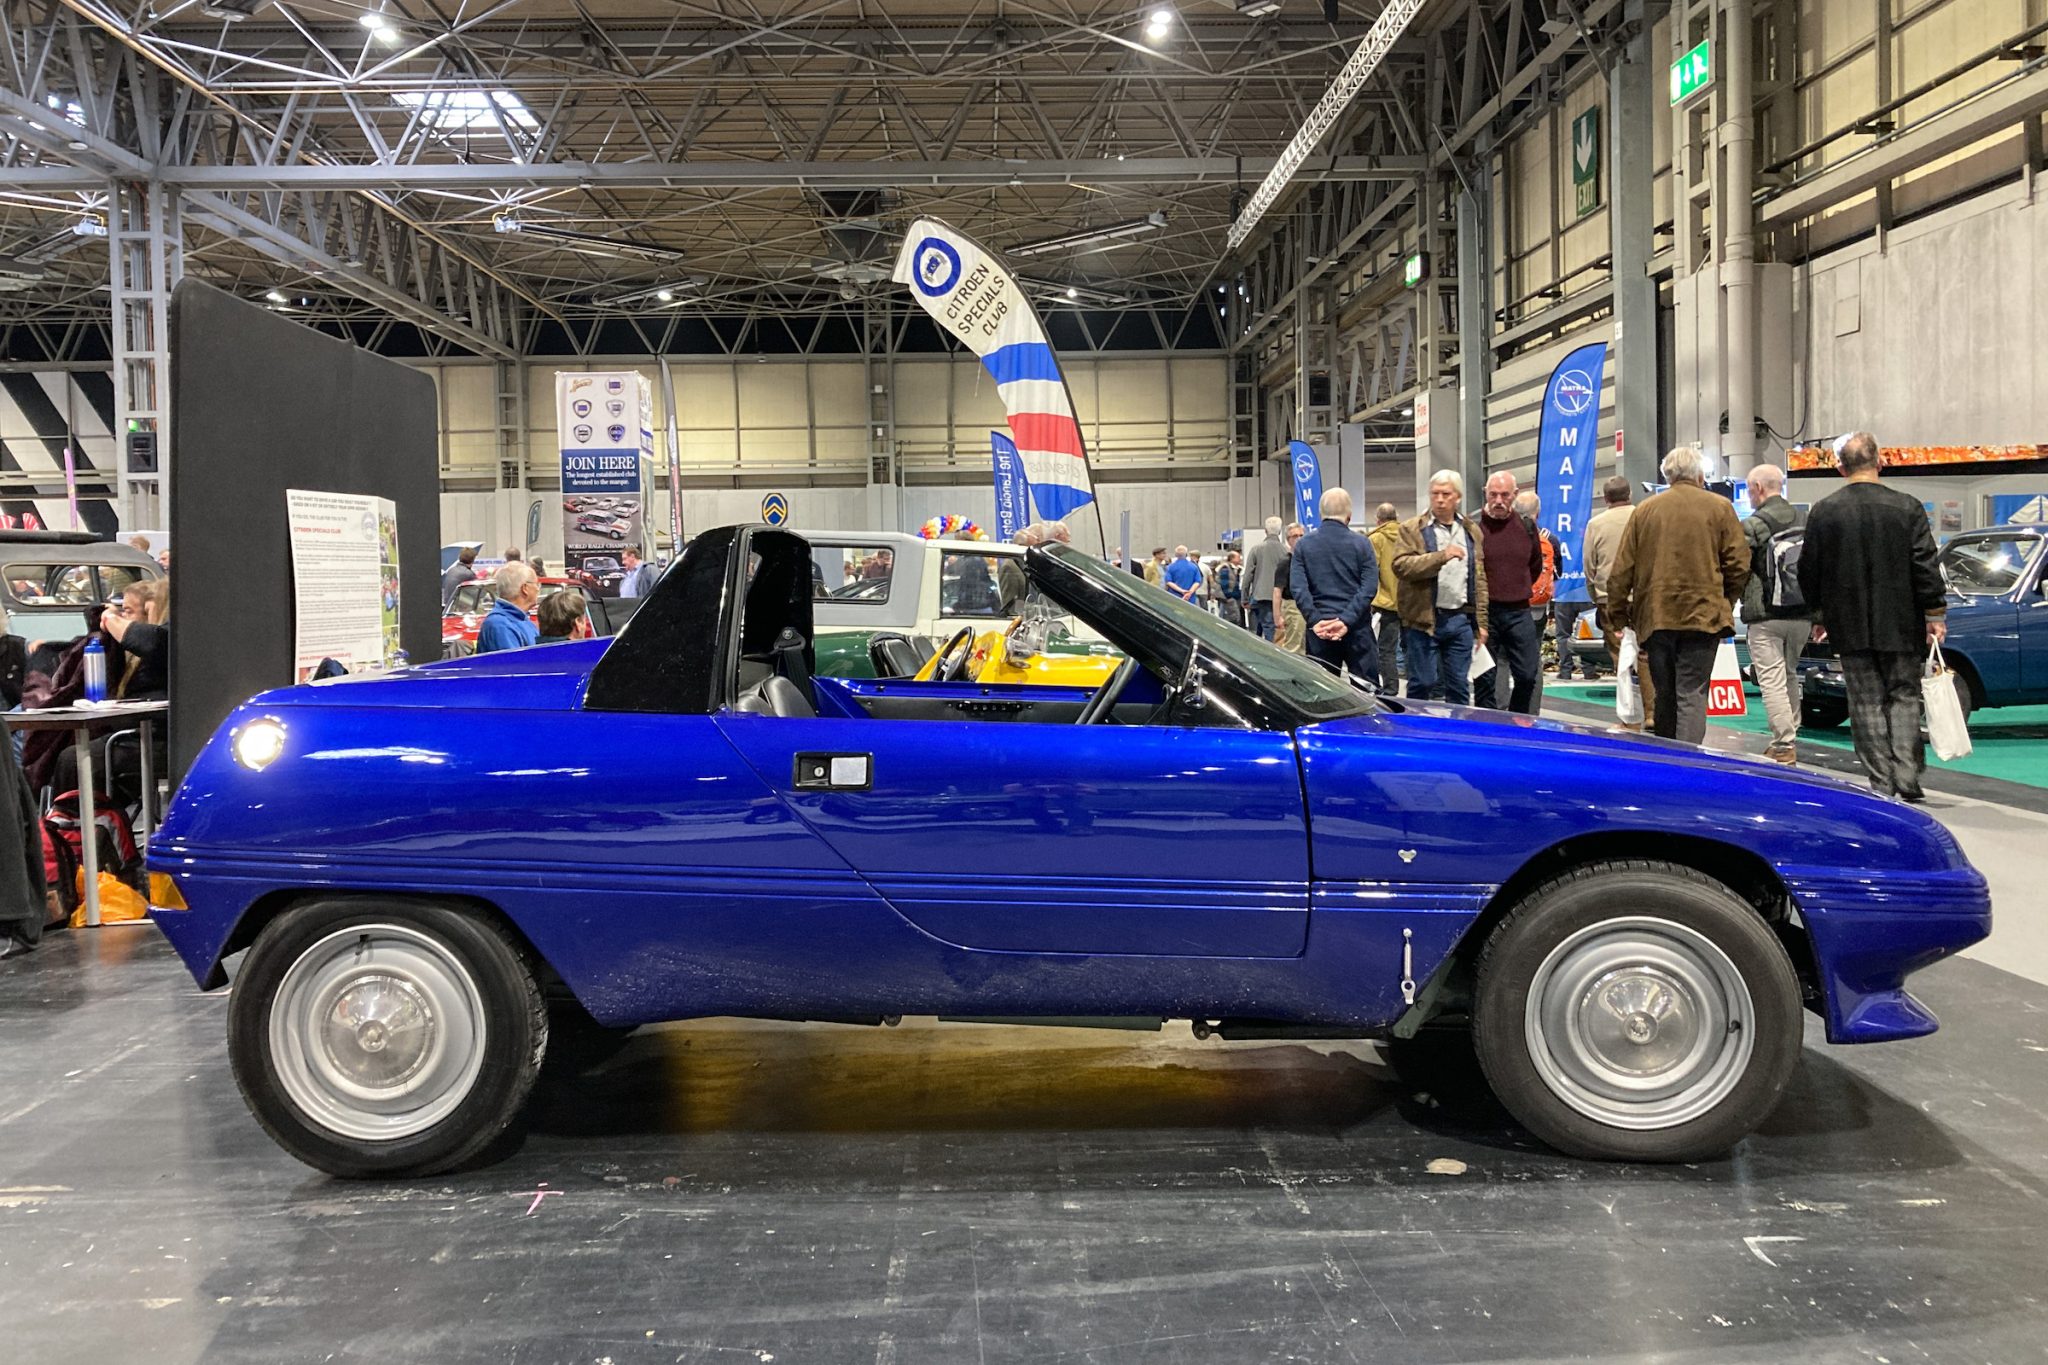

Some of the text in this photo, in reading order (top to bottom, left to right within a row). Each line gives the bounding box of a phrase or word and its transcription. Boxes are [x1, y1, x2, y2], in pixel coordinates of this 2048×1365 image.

[1577, 178, 1593, 211] EXIT
[946, 263, 990, 320] CITROEN
[958, 275, 1005, 334] SPECIALS
[982, 301, 1008, 336] CLUB
[565, 456, 636, 471] JOIN HERE
[1302, 488, 1314, 533] MAT
[1557, 427, 1578, 560] MATRA
